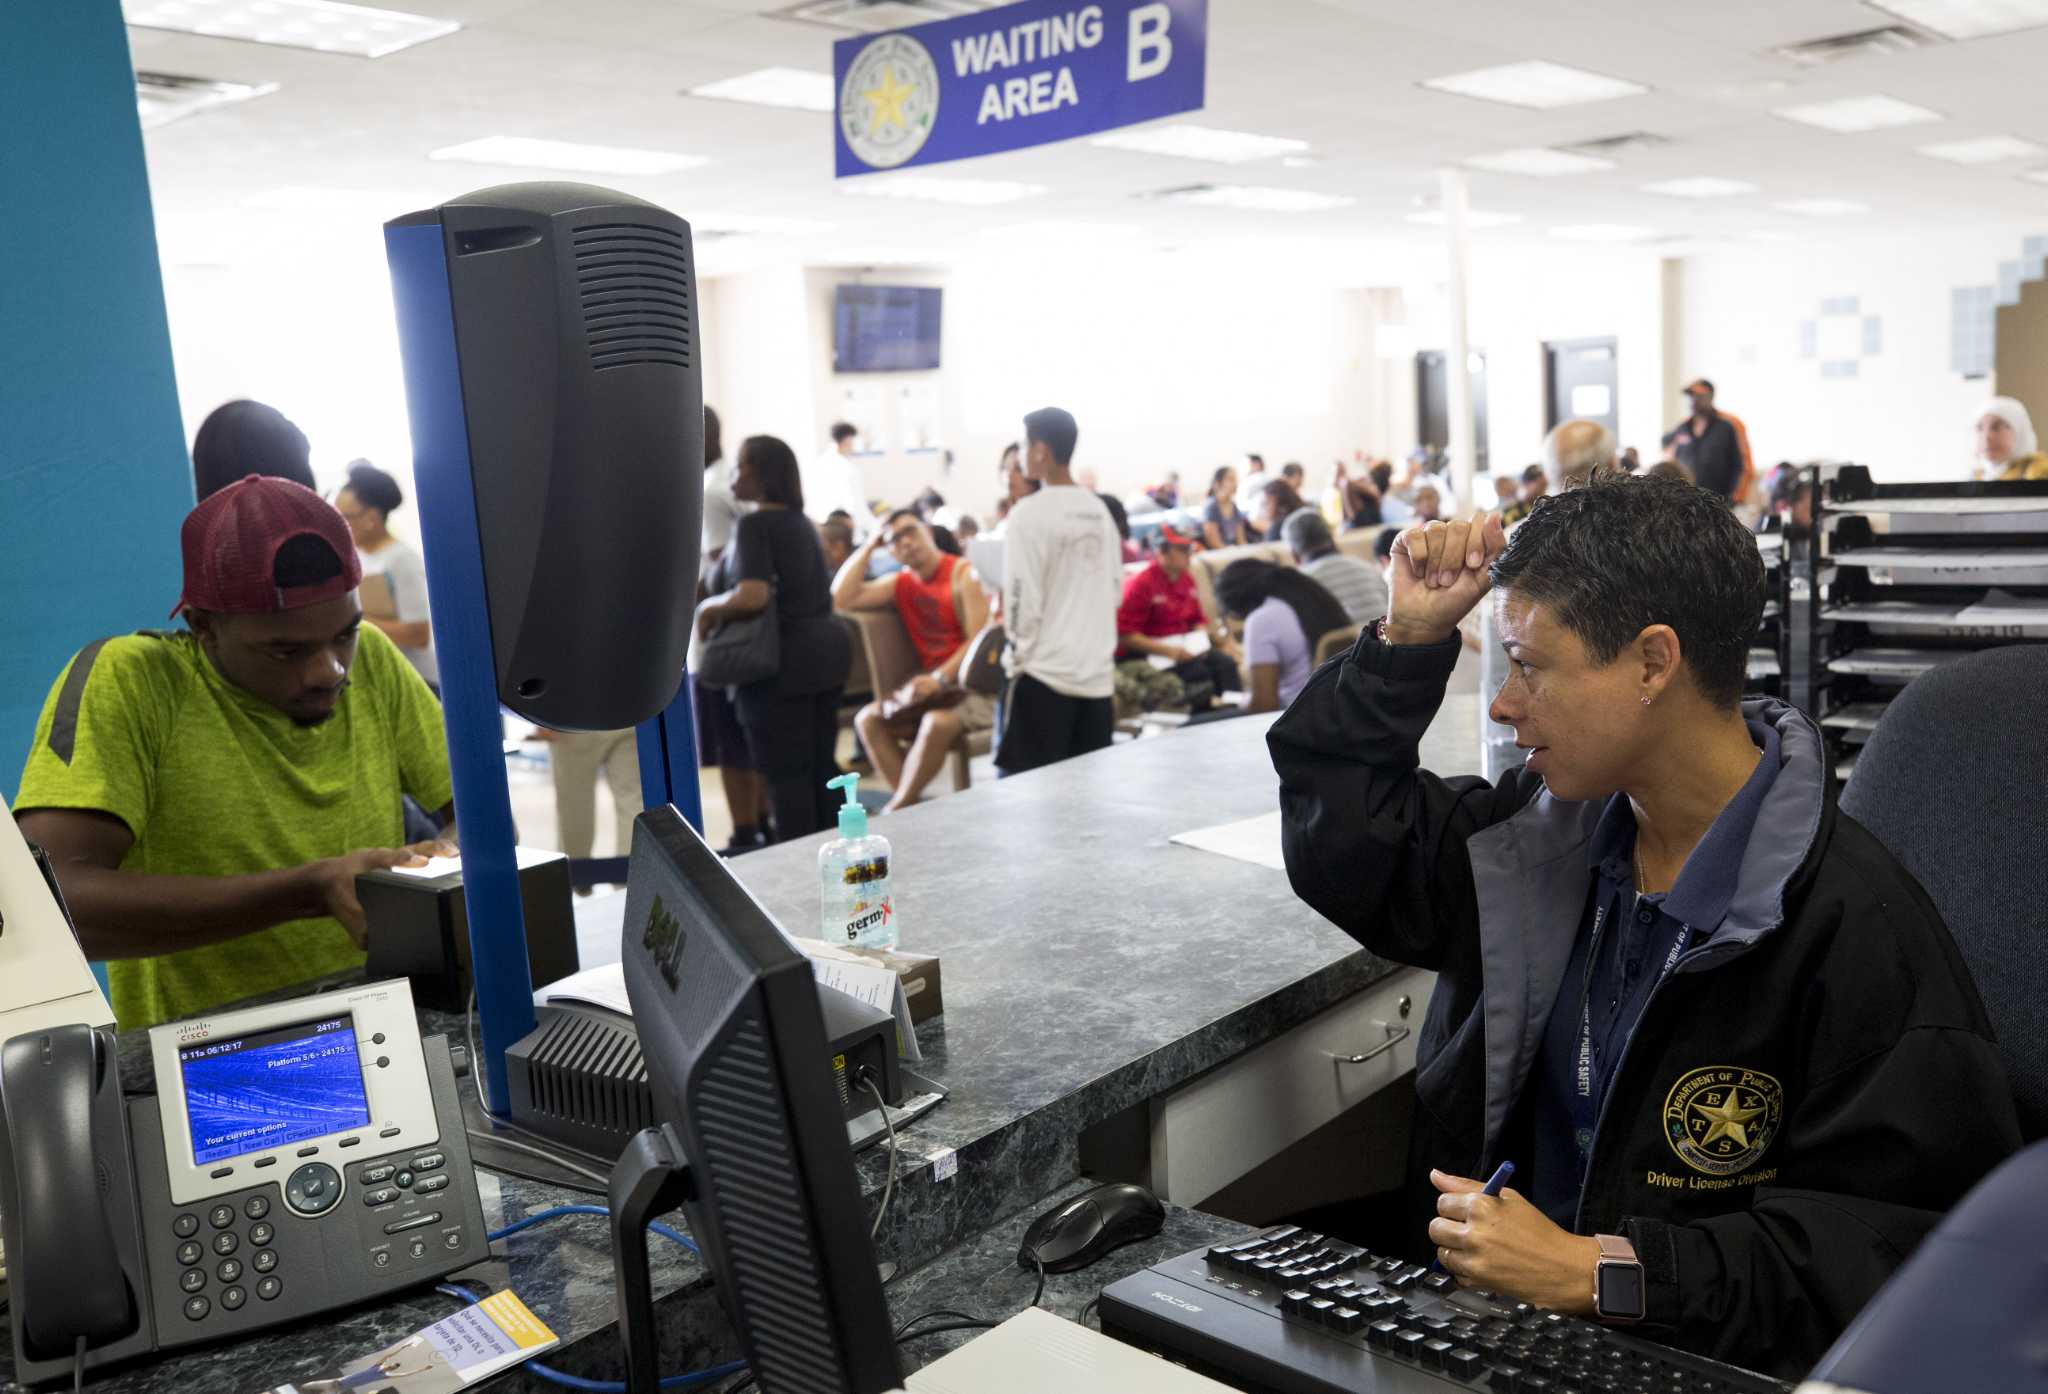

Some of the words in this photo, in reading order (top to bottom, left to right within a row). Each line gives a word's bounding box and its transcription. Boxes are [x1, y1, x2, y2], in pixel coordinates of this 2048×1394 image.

[951, 6, 1104, 77] WAITING
[1126, 2, 1174, 82] B
[976, 67, 1079, 125] AREA
[317, 1021, 341, 1032] 24175
[268, 1056, 301, 1069] Platform
[1579, 1037, 1590, 1065] PUBLIC
[1578, 1065, 1591, 1097] SAFETY
[1668, 1073, 1716, 1122] DEPARTMENT
[1718, 1073, 1733, 1081] OF
[205, 1136, 224, 1145] Your
[226, 1129, 256, 1140] current
[257, 1122, 287, 1134] options
[1647, 1170, 1685, 1190] Driver
[1689, 1176, 1736, 1190] License
[217, 1209, 225, 1219] 2
[253, 1200, 260, 1210] 3
[185, 1246, 192, 1255] 4
[221, 1236, 229, 1246] 5
[257, 1227, 264, 1236] 6
[189, 1273, 196, 1283] 7
[225, 1263, 233, 1273] 8
[261, 1254, 269, 1263] 9
